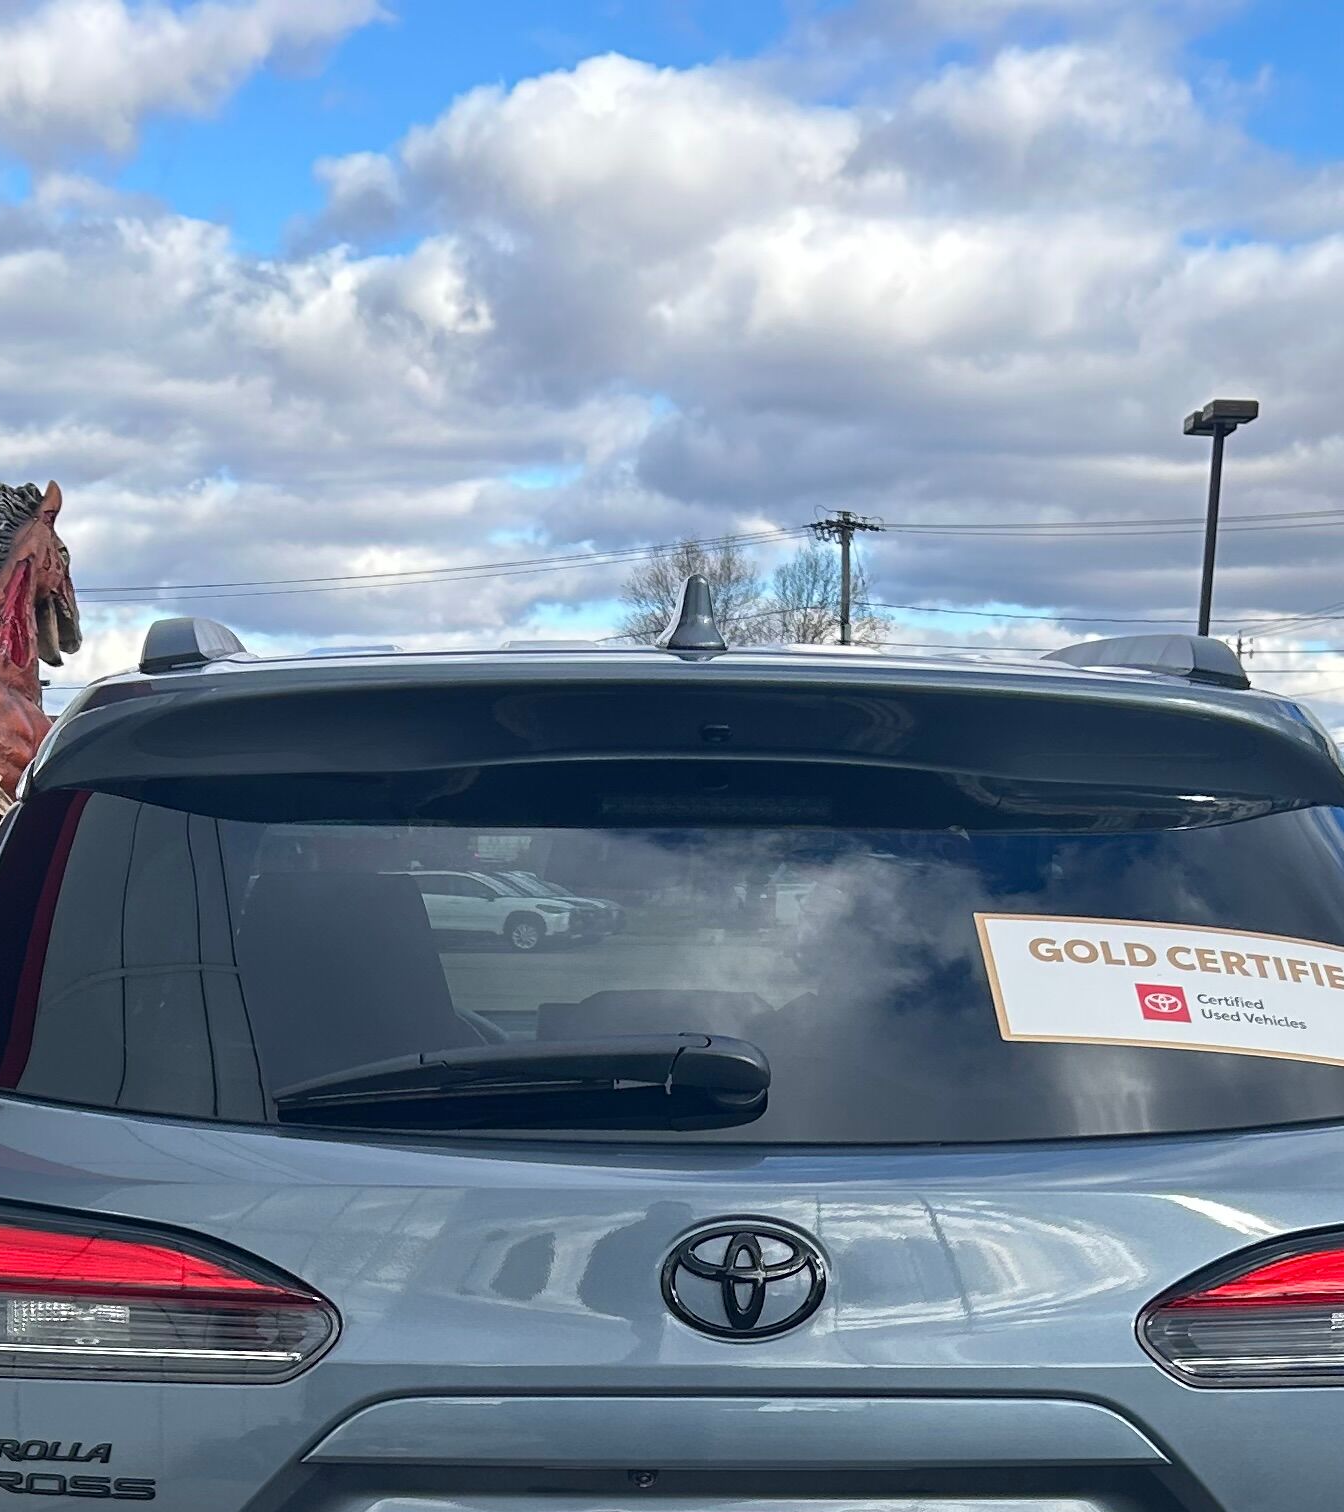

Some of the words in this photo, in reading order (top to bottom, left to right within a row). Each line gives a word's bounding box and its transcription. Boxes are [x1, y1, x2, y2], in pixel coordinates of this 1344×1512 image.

[1028, 937, 1157, 968] GOLD
[1197, 992, 1264, 1010] Certified
[1201, 1008, 1242, 1023] Used
[1243, 1012, 1307, 1030] Vehicles
